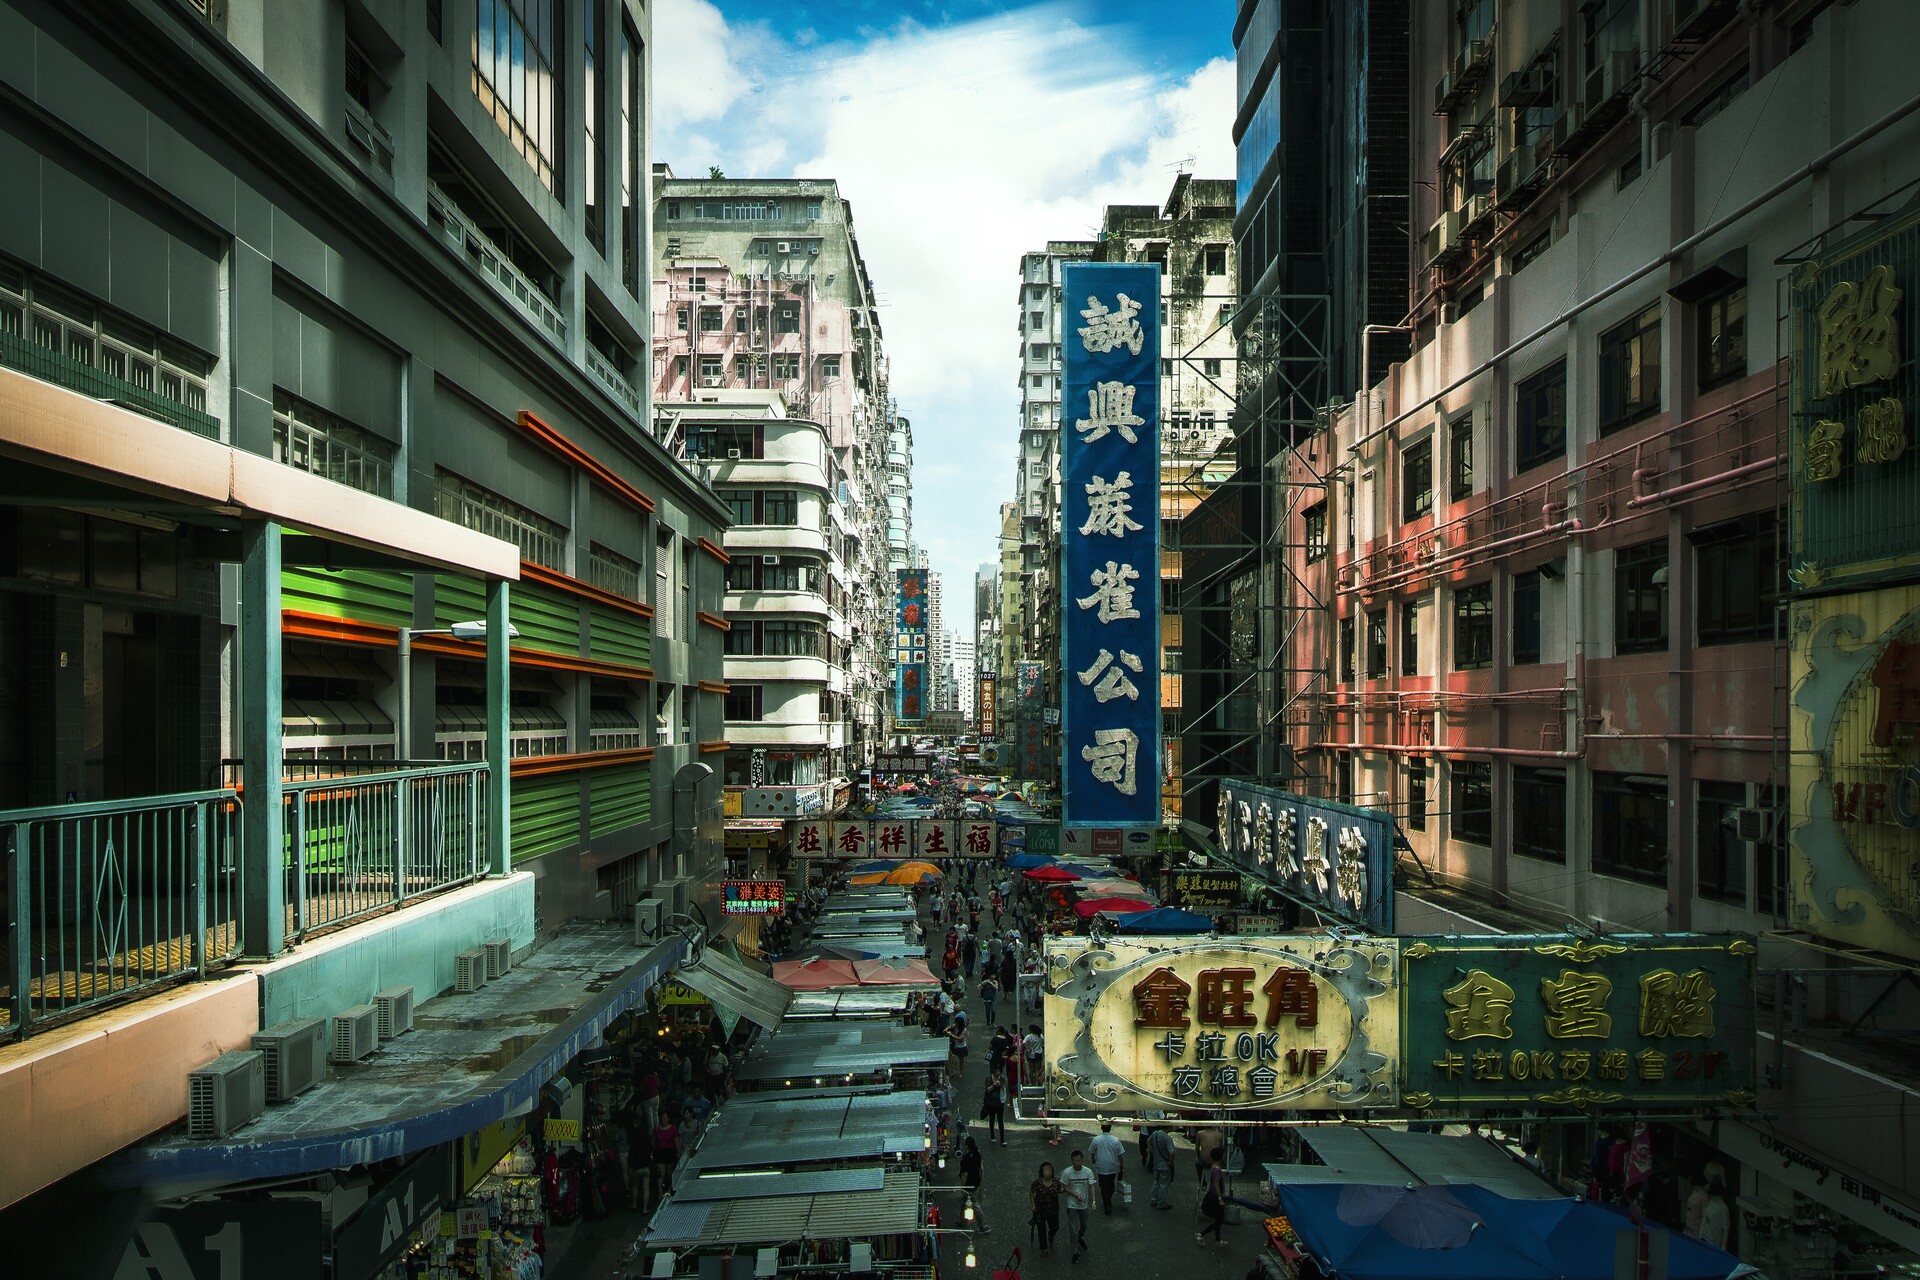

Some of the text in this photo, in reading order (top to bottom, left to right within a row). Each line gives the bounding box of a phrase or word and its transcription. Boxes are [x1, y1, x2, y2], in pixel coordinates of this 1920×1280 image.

[739, 885, 780, 900] 雅美姿
[1133, 966, 1319, 1030] 金旺角
[1155, 1031, 1281, 1062] 卡拉OK
[1172, 1065, 1279, 1097] 夜總會
[380, 1180, 415, 1255] A1
[110, 1221, 244, 1280] A1
